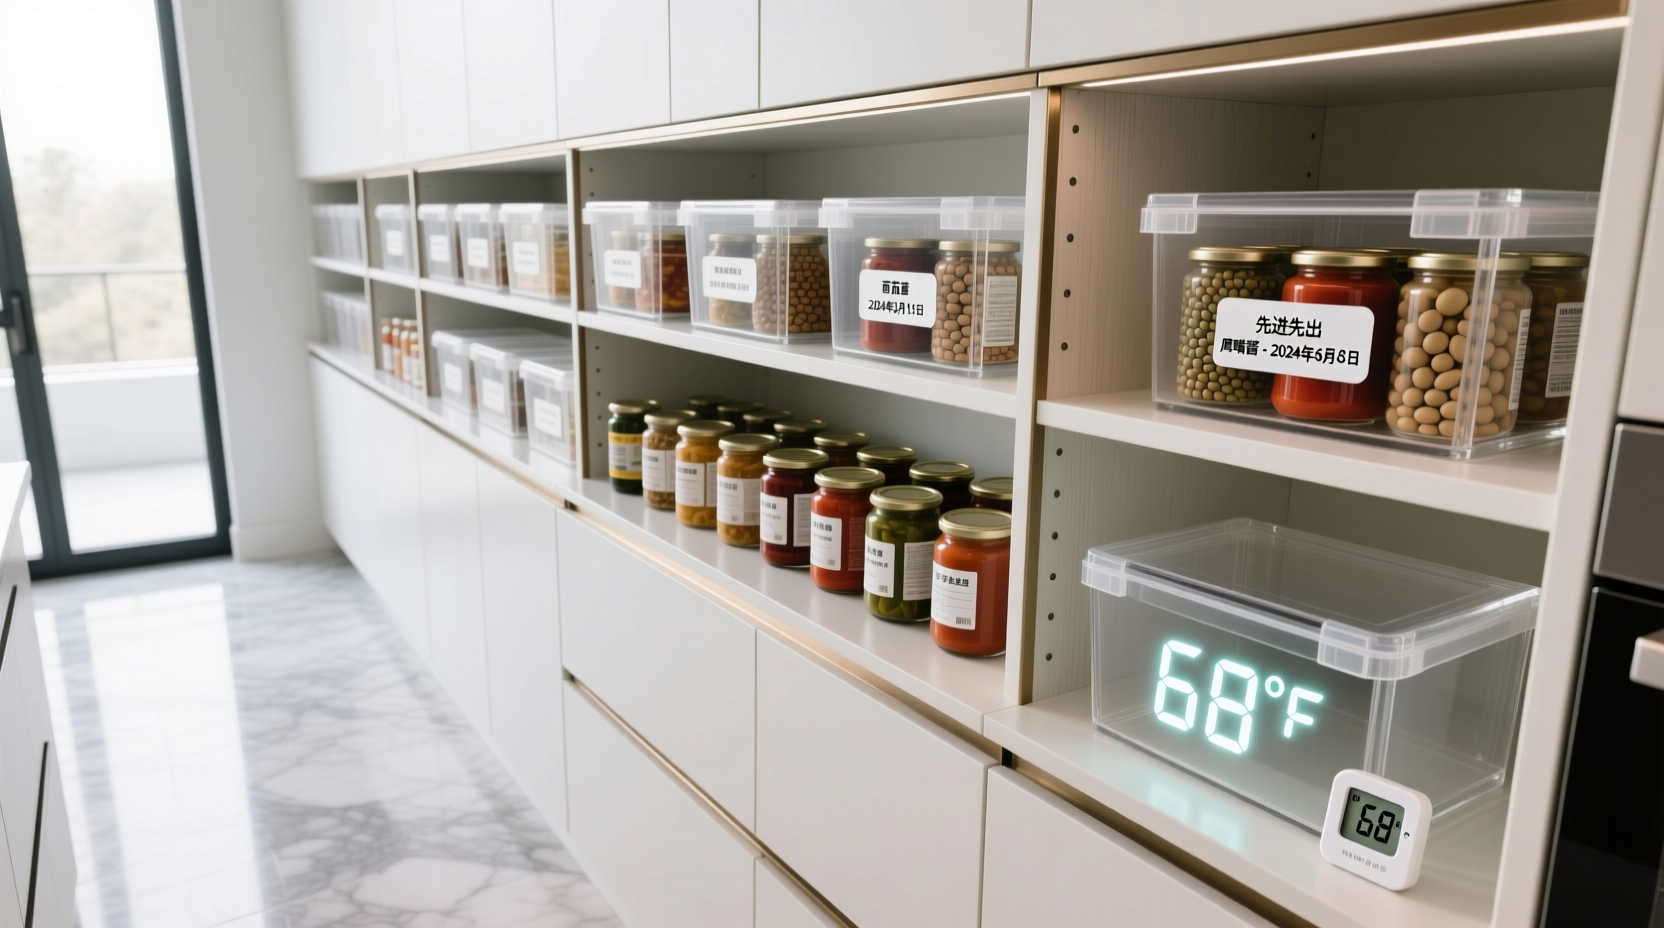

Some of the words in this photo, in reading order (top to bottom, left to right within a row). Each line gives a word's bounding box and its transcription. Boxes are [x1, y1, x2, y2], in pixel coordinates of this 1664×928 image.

[1256, 315, 1322, 338] 先进先出
[1154, 639, 1324, 754] 68°F
[1356, 804, 1396, 845] 68
